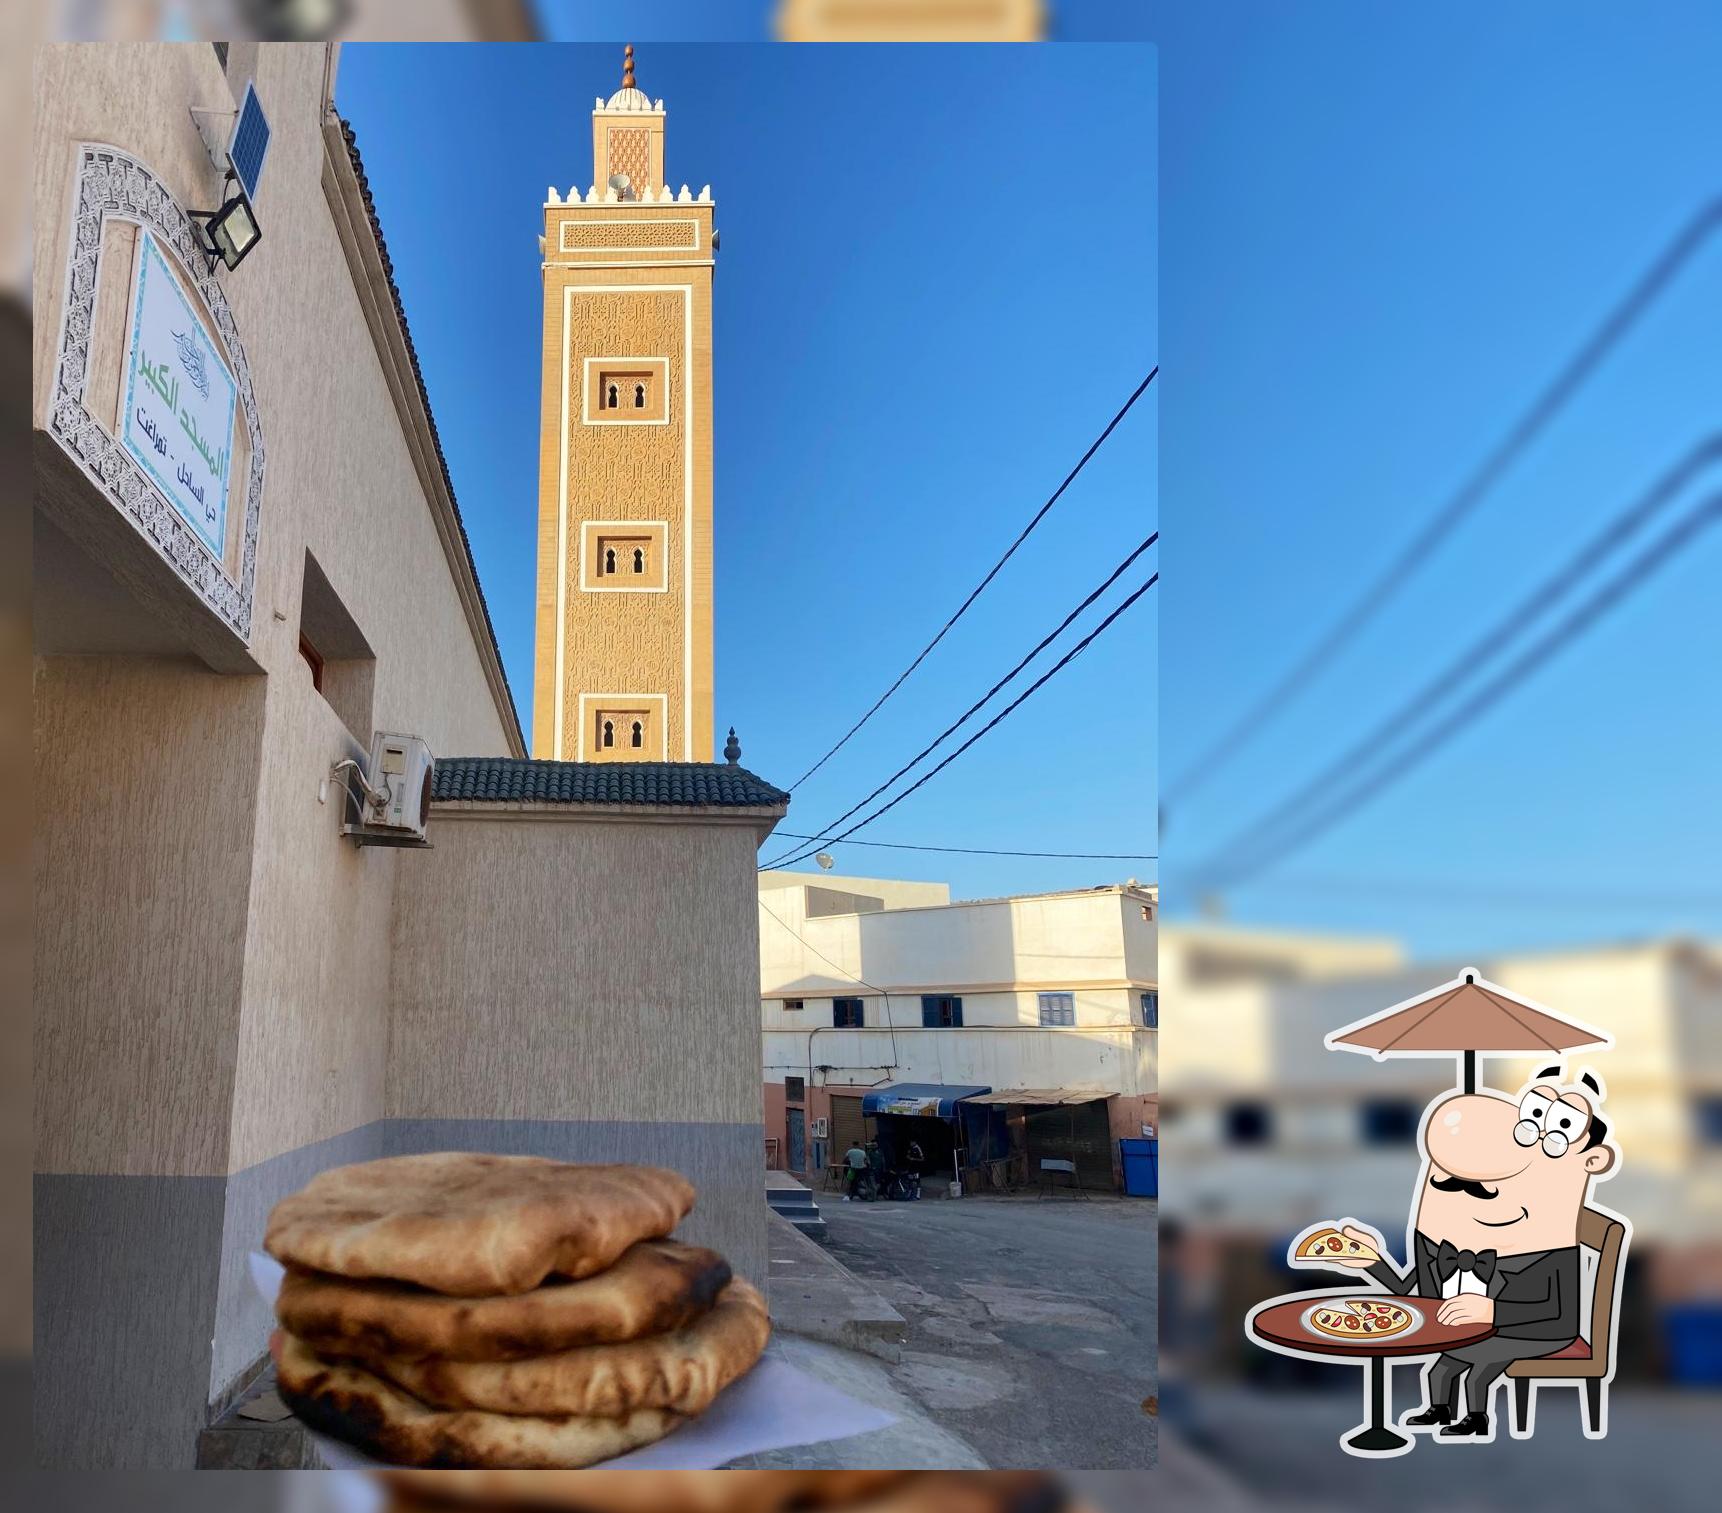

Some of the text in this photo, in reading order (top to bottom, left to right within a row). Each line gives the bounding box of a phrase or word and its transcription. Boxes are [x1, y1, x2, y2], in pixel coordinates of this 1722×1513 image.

[138, 350, 179, 415] الكبير
[136, 407, 168, 457] تمراغت
[180, 407, 224, 481] المسجد
[177, 462, 205, 506] الساحل
[205, 504, 216, 524] حي
